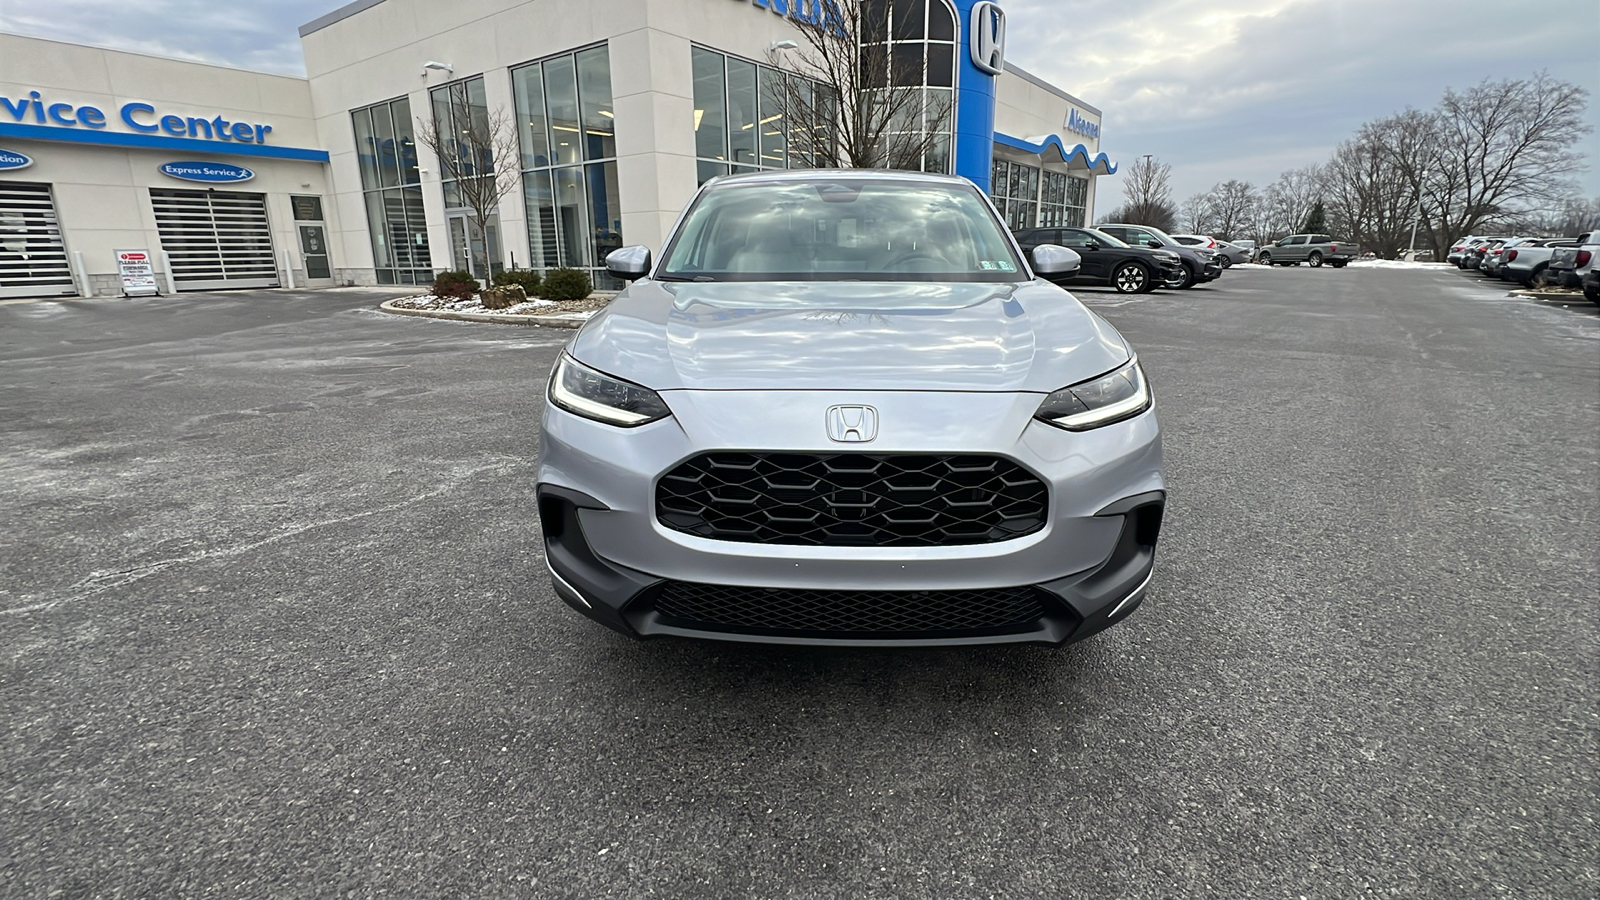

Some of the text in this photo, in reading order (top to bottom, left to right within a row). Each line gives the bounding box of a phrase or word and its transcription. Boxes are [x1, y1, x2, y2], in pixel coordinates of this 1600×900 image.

[120, 102, 272, 144] Center
[165, 165, 237, 177] Express Service
